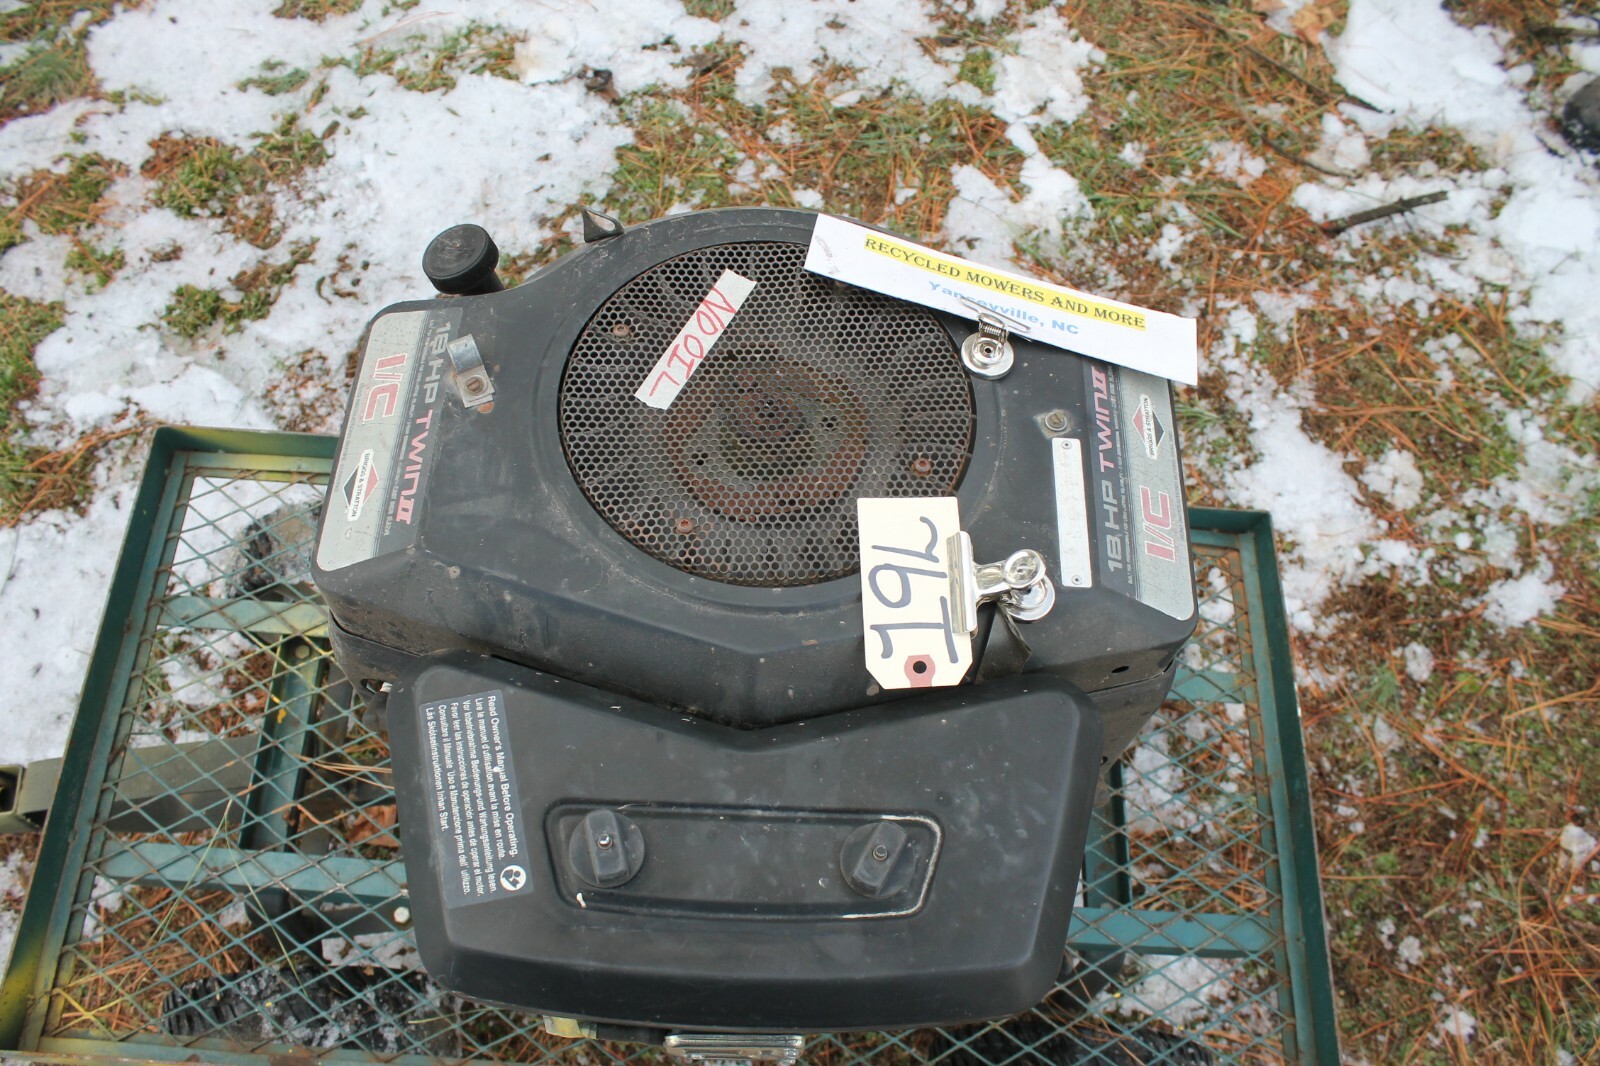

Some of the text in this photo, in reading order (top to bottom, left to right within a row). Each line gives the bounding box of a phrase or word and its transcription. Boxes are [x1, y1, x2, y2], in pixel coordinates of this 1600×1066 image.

[865, 237, 1146, 329] RECYCLED MOWERS AND MORE
[1051, 319, 1079, 335] NC
[423, 358, 444, 404] HP
[1094, 391, 1115, 473] TWIN
[403, 409, 433, 498] TWIN
[1101, 479, 1121, 531] HP
[1105, 532, 1123, 572] 18
[449, 701, 460, 719] Favor
[462, 699, 471, 711] Vor
[474, 697, 484, 710] Lire
[437, 704, 450, 737] Consultare
[452, 719, 461, 730] leer
[477, 718, 489, 743] manuel
[454, 731, 463, 740] las
[463, 711, 478, 758] Inbetriebnahme
[442, 742, 454, 768] Manuale
[454, 740, 469, 780] instrucciones
[481, 743, 495, 782] d'utilisation
[425, 707, 435, 719] Läs
[438, 811, 450, 831] Start.
[486, 695, 520, 857] Read Owner's Manual Before Operating.
[460, 789, 475, 820] operación
[487, 782, 497, 802] avant
[448, 789, 463, 834] Manutenzione
[491, 810, 502, 828] mise
[466, 820, 476, 837] antes
[453, 834, 466, 854] prima
[475, 811, 495, 873] Wartungsanleitung
[495, 838, 506, 860] route.
[468, 847, 479, 868] operar
[460, 869, 472, 894] utilizzo.
[474, 875, 485, 896] motor.
[487, 872, 498, 893] lesen.
